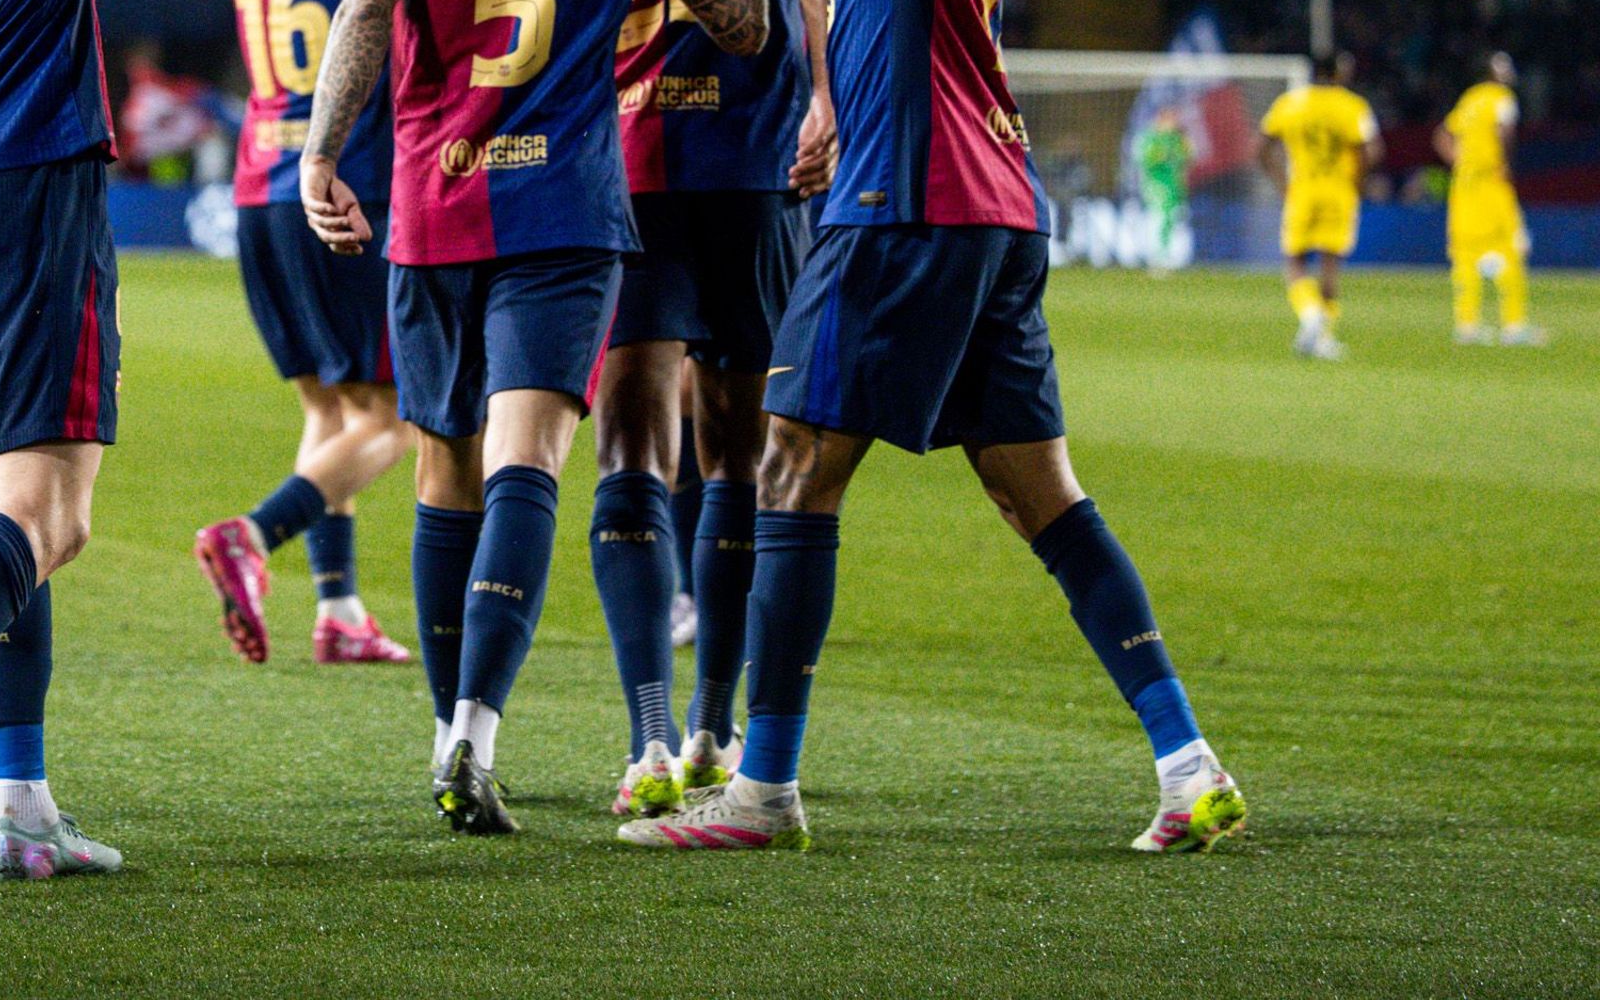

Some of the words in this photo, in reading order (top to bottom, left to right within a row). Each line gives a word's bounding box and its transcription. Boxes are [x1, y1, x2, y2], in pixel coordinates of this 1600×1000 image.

[656, 76, 719, 90] UNHCR
[655, 90, 720, 105] ACNUR
[485, 135, 547, 151] UNHCR
[481, 148, 548, 165] ACNUR
